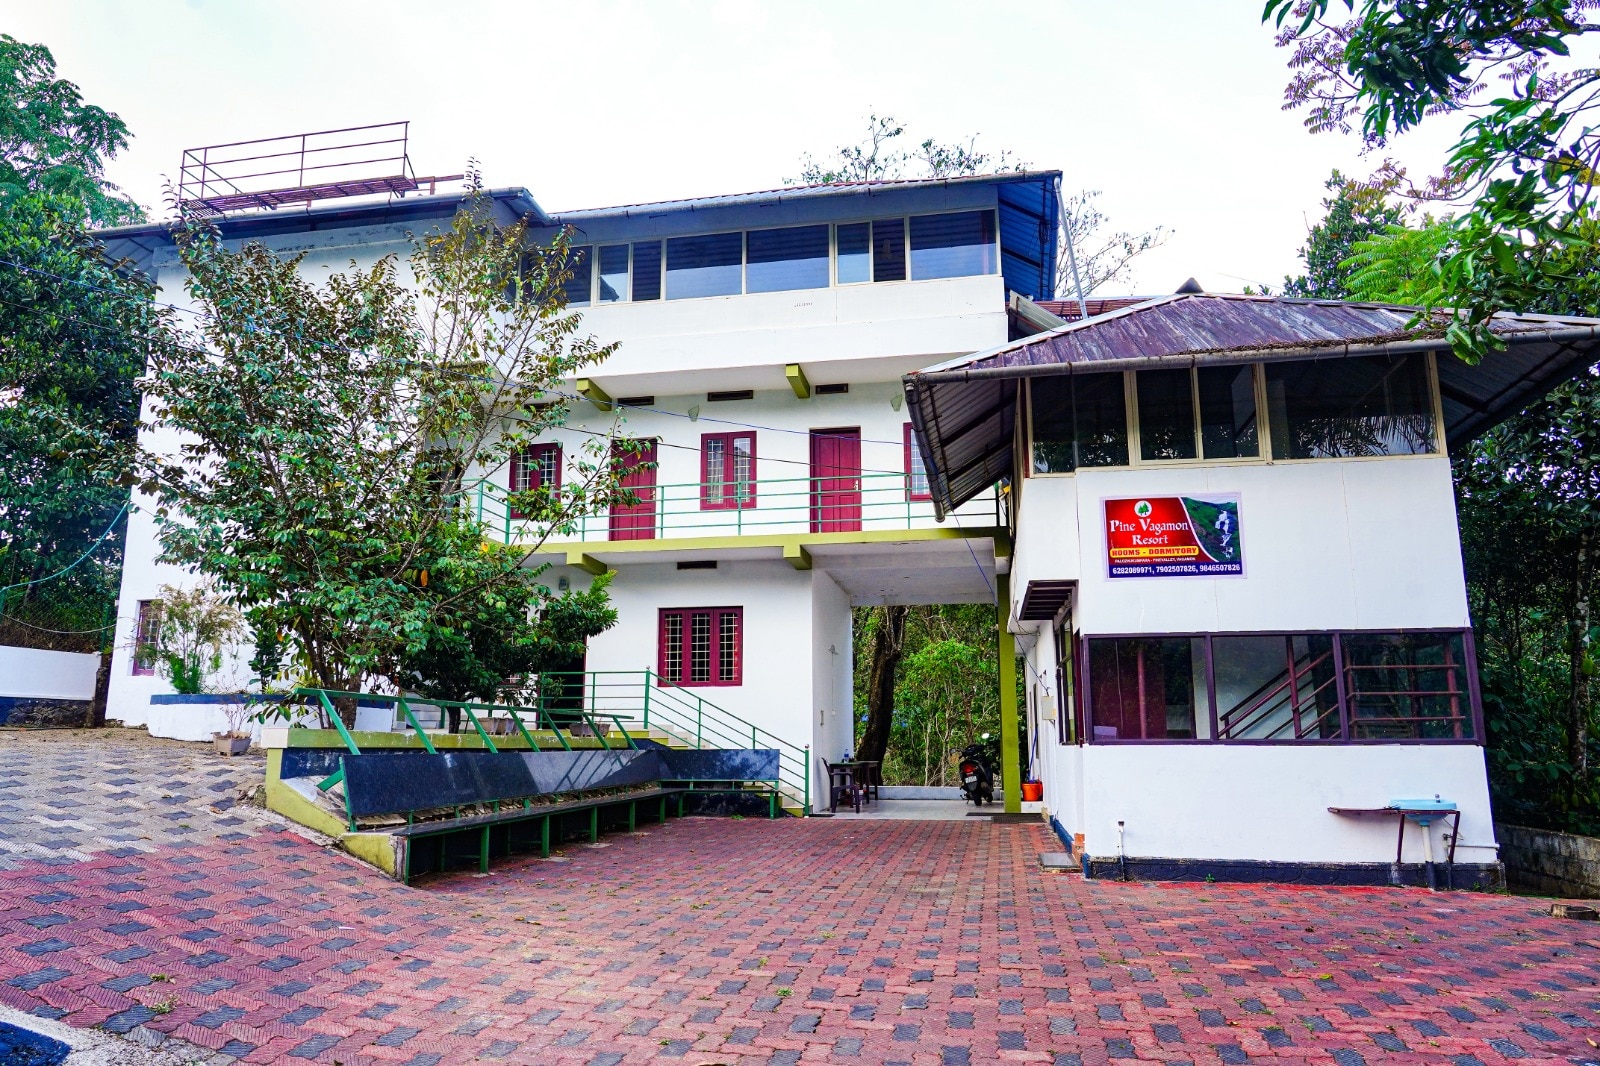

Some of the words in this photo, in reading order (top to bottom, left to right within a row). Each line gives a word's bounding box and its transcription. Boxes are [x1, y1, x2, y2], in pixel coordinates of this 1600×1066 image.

[1109, 519, 1136, 532] Pine
[1138, 518, 1189, 535] Vagamon
[1132, 534, 1169, 545] Resort
[1111, 548, 1140, 557] ROOMS
[1148, 546, 1197, 556] DORMITORY
[1112, 565, 1155, 575] 6282089971,
[1155, 564, 1199, 574] 7902507826,
